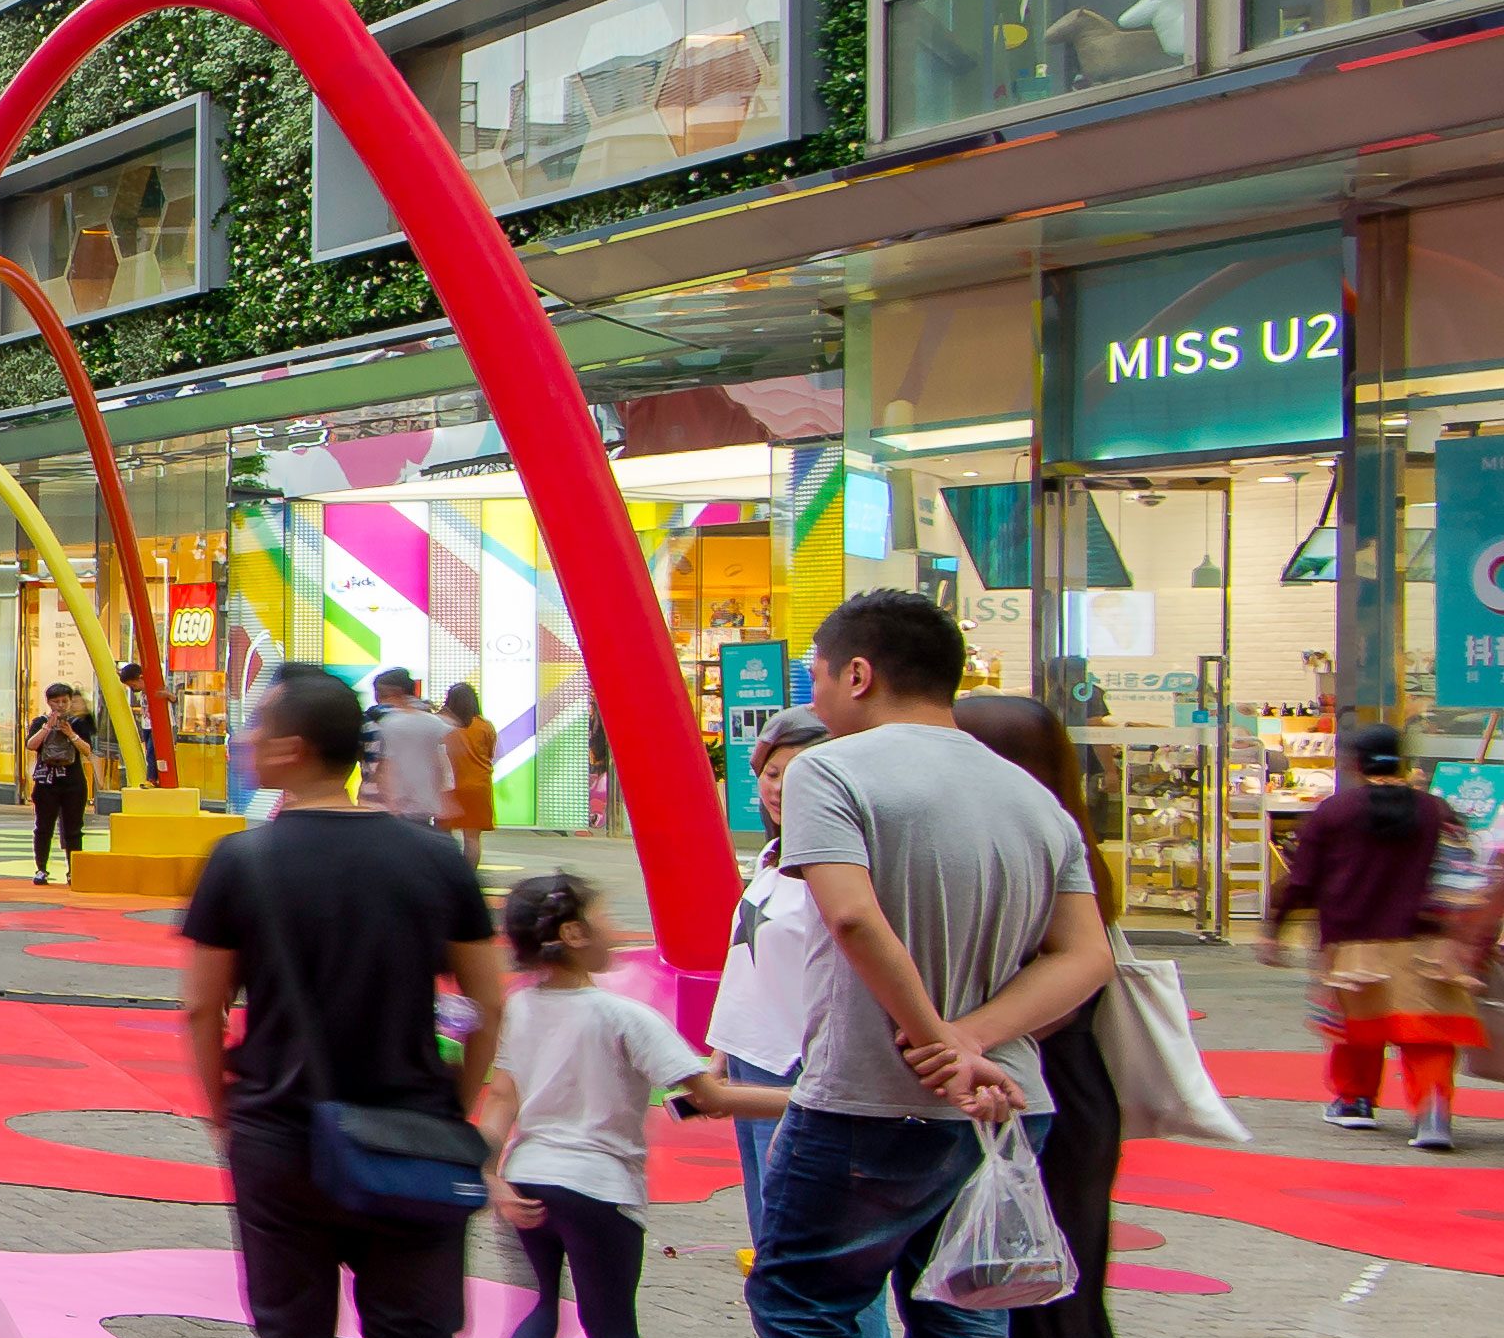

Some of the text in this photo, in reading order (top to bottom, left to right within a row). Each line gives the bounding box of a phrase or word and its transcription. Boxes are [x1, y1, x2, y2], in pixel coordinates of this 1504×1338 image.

[1107, 312, 1342, 384] MISS U2
[173, 609, 214, 645] LEGO
[964, 596, 1021, 622] ISS
